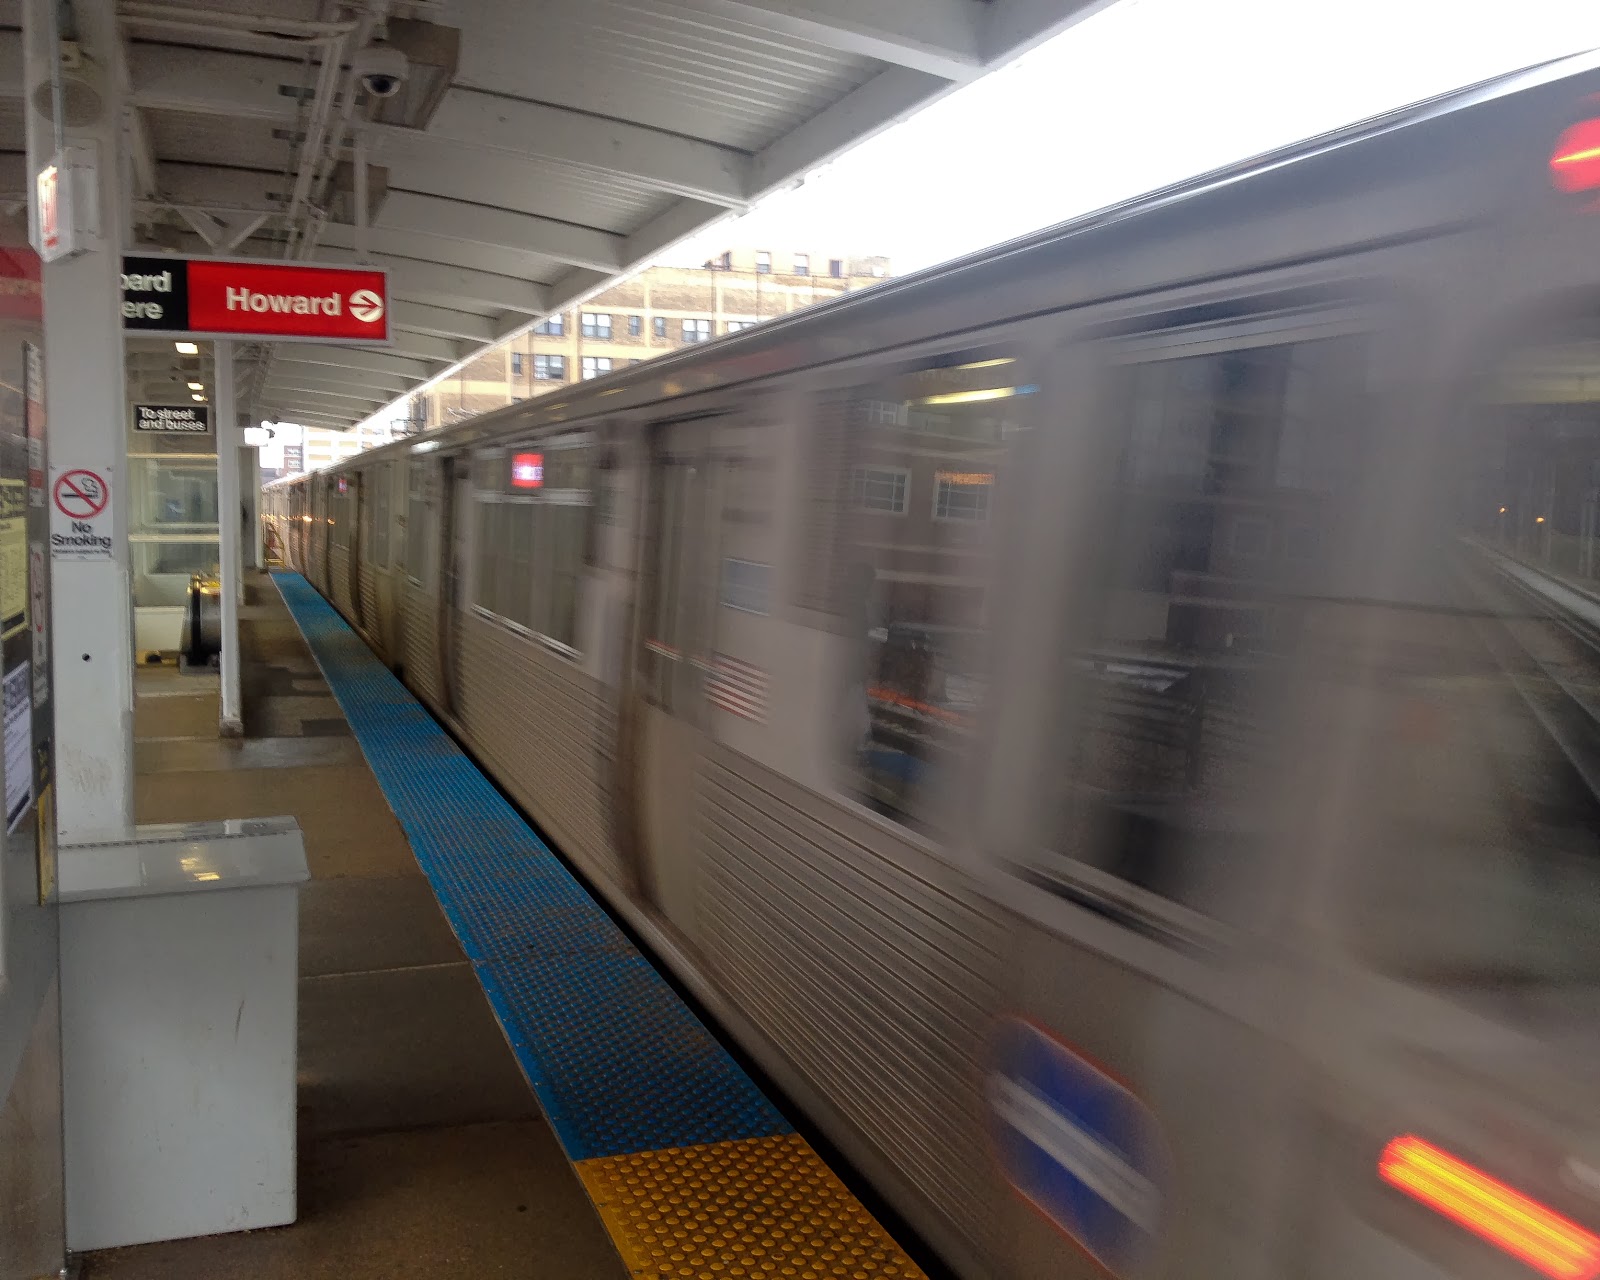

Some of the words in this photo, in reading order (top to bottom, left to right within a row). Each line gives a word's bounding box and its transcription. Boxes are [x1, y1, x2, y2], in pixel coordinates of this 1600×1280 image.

[226, 286, 341, 316] Howard
[121, 301, 163, 320] ere
[138, 406, 156, 418] To
[157, 406, 196, 420] street
[138, 418, 164, 430] and
[164, 418, 206, 431] buses
[71, 521, 93, 533] No
[51, 533, 112, 549] Smoking
